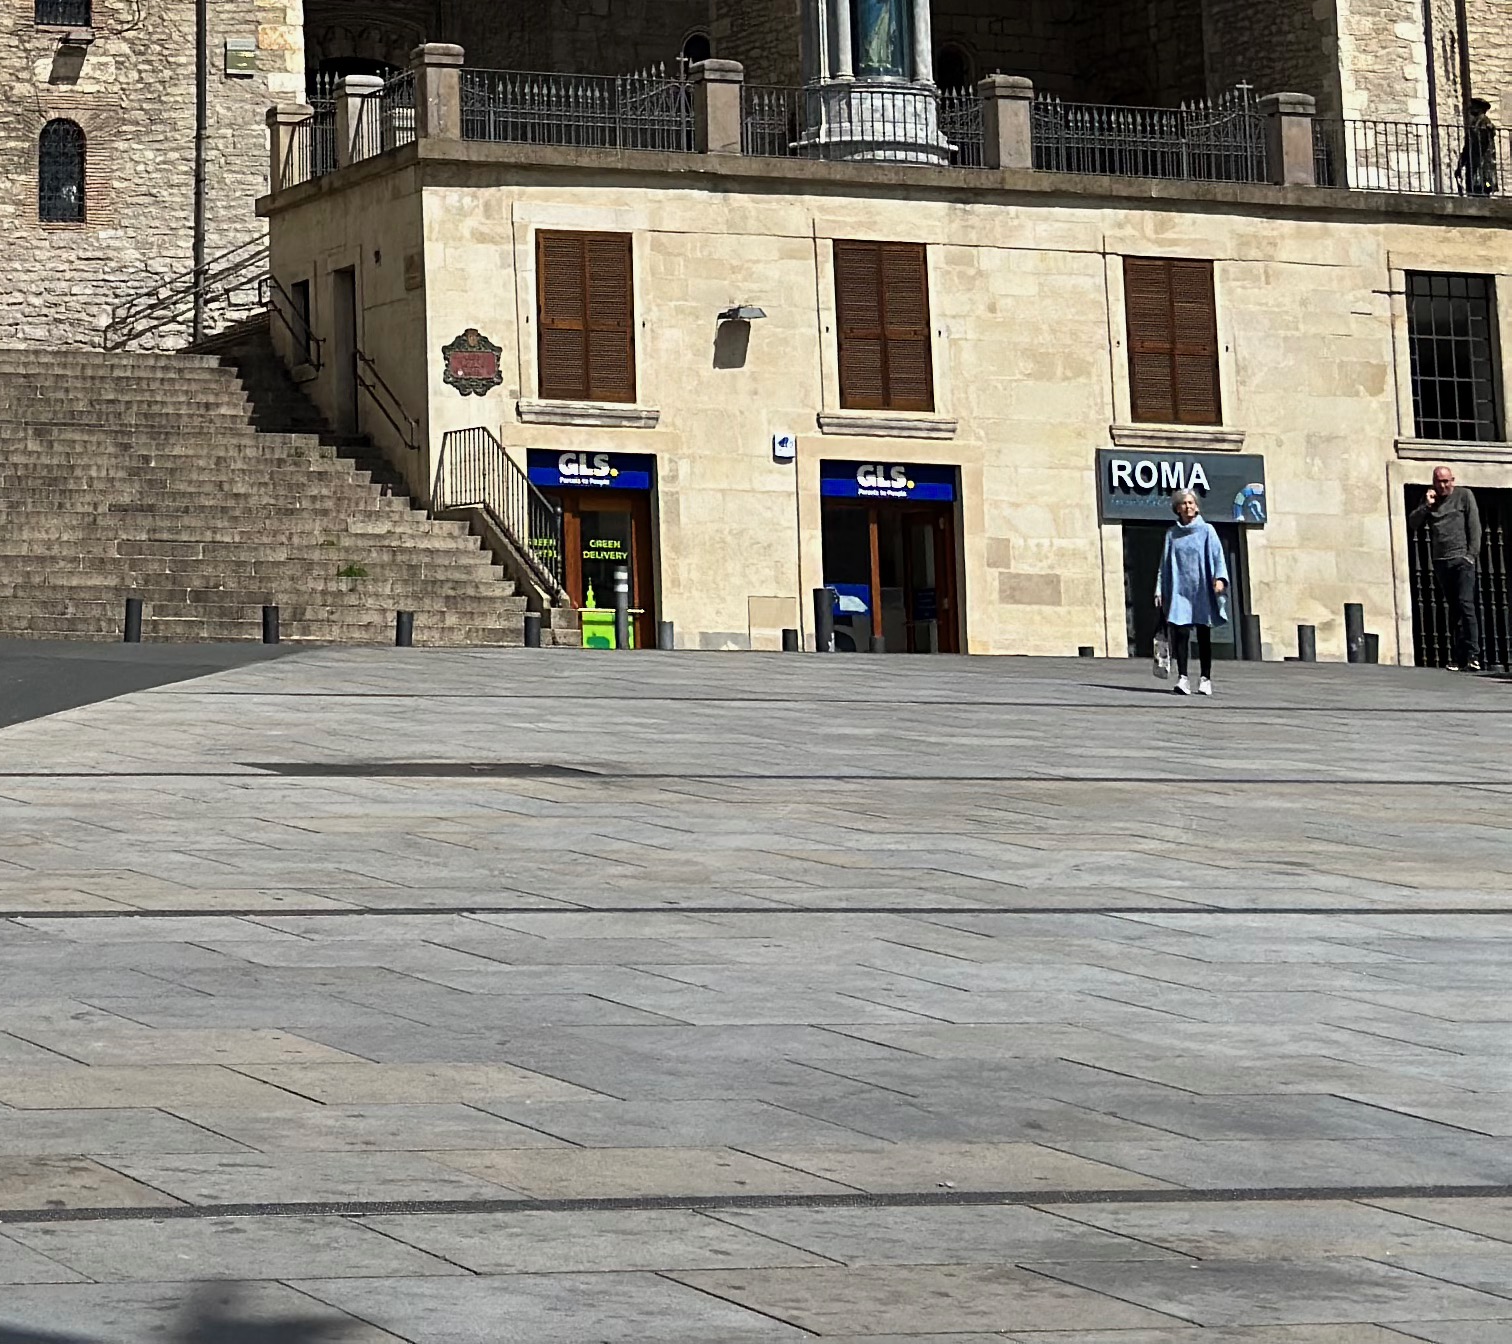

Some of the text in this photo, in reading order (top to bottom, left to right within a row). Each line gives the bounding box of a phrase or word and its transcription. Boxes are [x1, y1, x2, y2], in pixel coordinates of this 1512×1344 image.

[1111, 459, 1211, 491] ROMA
[589, 539, 621, 548] GREEN
[582, 550, 628, 560] DELIVERY
